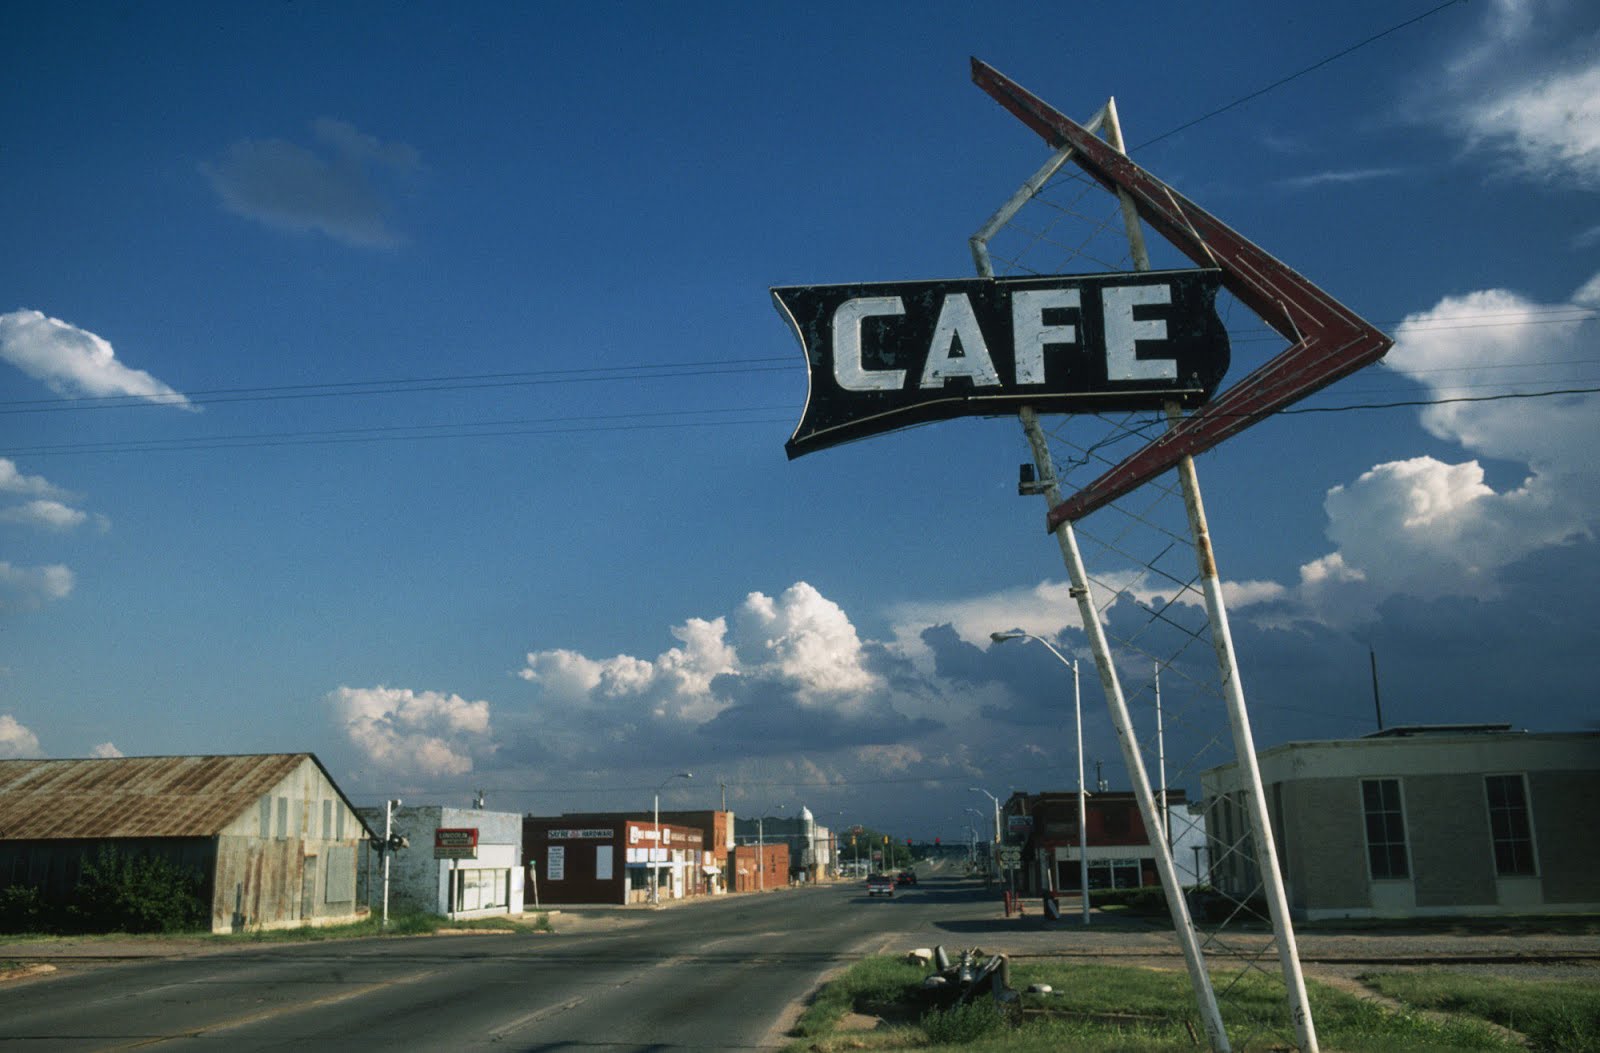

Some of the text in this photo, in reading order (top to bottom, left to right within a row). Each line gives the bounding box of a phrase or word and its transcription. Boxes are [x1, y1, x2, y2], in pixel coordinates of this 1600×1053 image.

[832, 284, 1178, 392] CAFE
[439, 832, 468, 840] LINCOLN
[582, 829, 613, 838] HARDWARE
